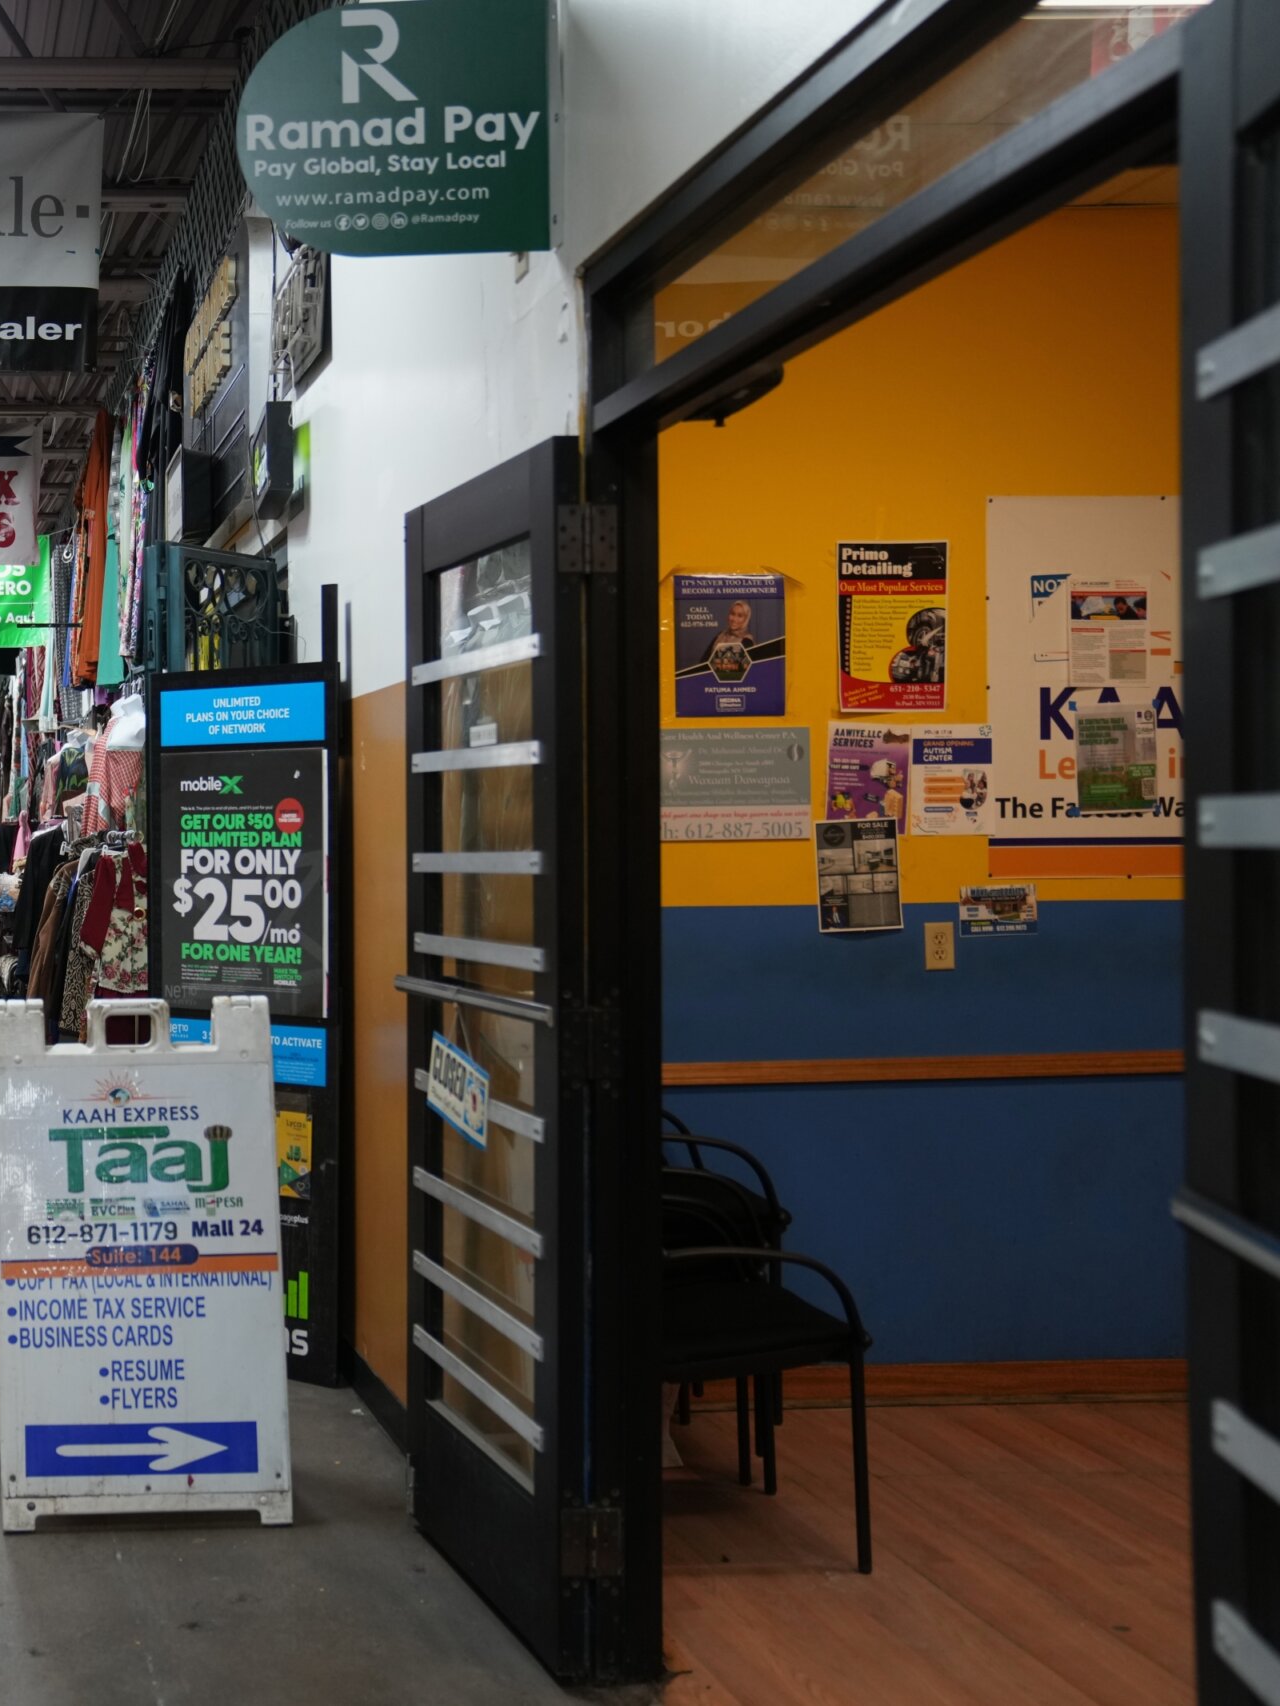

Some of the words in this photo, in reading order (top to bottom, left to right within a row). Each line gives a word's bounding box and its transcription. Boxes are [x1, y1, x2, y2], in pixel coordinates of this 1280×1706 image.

[246, 107, 425, 150] Ramad
[444, 105, 540, 150] Pay
[254, 160, 296, 180] Pay
[304, 154, 382, 177] Global,
[387, 153, 439, 175] Stay
[447, 151, 506, 170] Local
[276, 186, 490, 207] www.ramadpay.com
[285, 219, 318, 230] Follow
[320, 221, 331, 229] us
[412, 212, 480, 224] @Ramadpay
[841, 547, 889, 561] Primo
[841, 562, 913, 578] Detailing
[839, 582, 856, 592] Our
[857, 582, 877, 592] Most
[878, 581, 909, 594] Popular
[910, 581, 944, 591] Services
[213, 696, 261, 709] UNLIMITED
[186, 711, 214, 723] PLANS
[216, 711, 229, 722] ON
[230, 710, 255, 722] YOUR
[257, 708, 290, 721] CHOICE
[208, 724, 221, 735] OF
[222, 722, 266, 735] NETWORK
[833, 738, 874, 748] SERVICES
[923, 754, 953, 762] CENTER
[180, 775, 244, 794] mobileX
[996, 797, 1044, 819] The
[180, 814, 211, 830] GET
[212, 814, 246, 829] OUR
[247, 813, 273, 830] $50
[663, 822, 678, 839] h:
[685, 821, 803, 839] 612-887-5005
[180, 832, 259, 848] UNLIMITED
[261, 831, 302, 847] PLAN
[180, 849, 231, 875] FOR
[234, 849, 302, 875] ONLY
[180, 943, 213, 960] FOR
[215, 943, 252, 962] ONE
[253, 944, 302, 964] YEAR!
[282, 1036, 323, 1049] ACTIVATE
[433, 1045, 466, 1102] CLOSED
[62, 1107, 116, 1124] KAAH
[123, 1105, 200, 1122] EXPRESS
[48, 1125, 233, 1193] Taaj
[27, 1221, 178, 1245] 612-871-1179
[191, 1220, 233, 1239] Mall
[240, 1219, 264, 1237] 24
[91, 1248, 142, 1265] Suite:
[149, 1247, 182, 1263] 144
[19, 1299, 88, 1321] INCOME
[93, 1298, 126, 1320] TAX
[131, 1296, 206, 1319] SERVICE
[19, 1327, 108, 1349] BUSINESS
[113, 1325, 174, 1347] CARDS
[111, 1359, 185, 1381] RESUME
[111, 1387, 178, 1409] FLYERS
